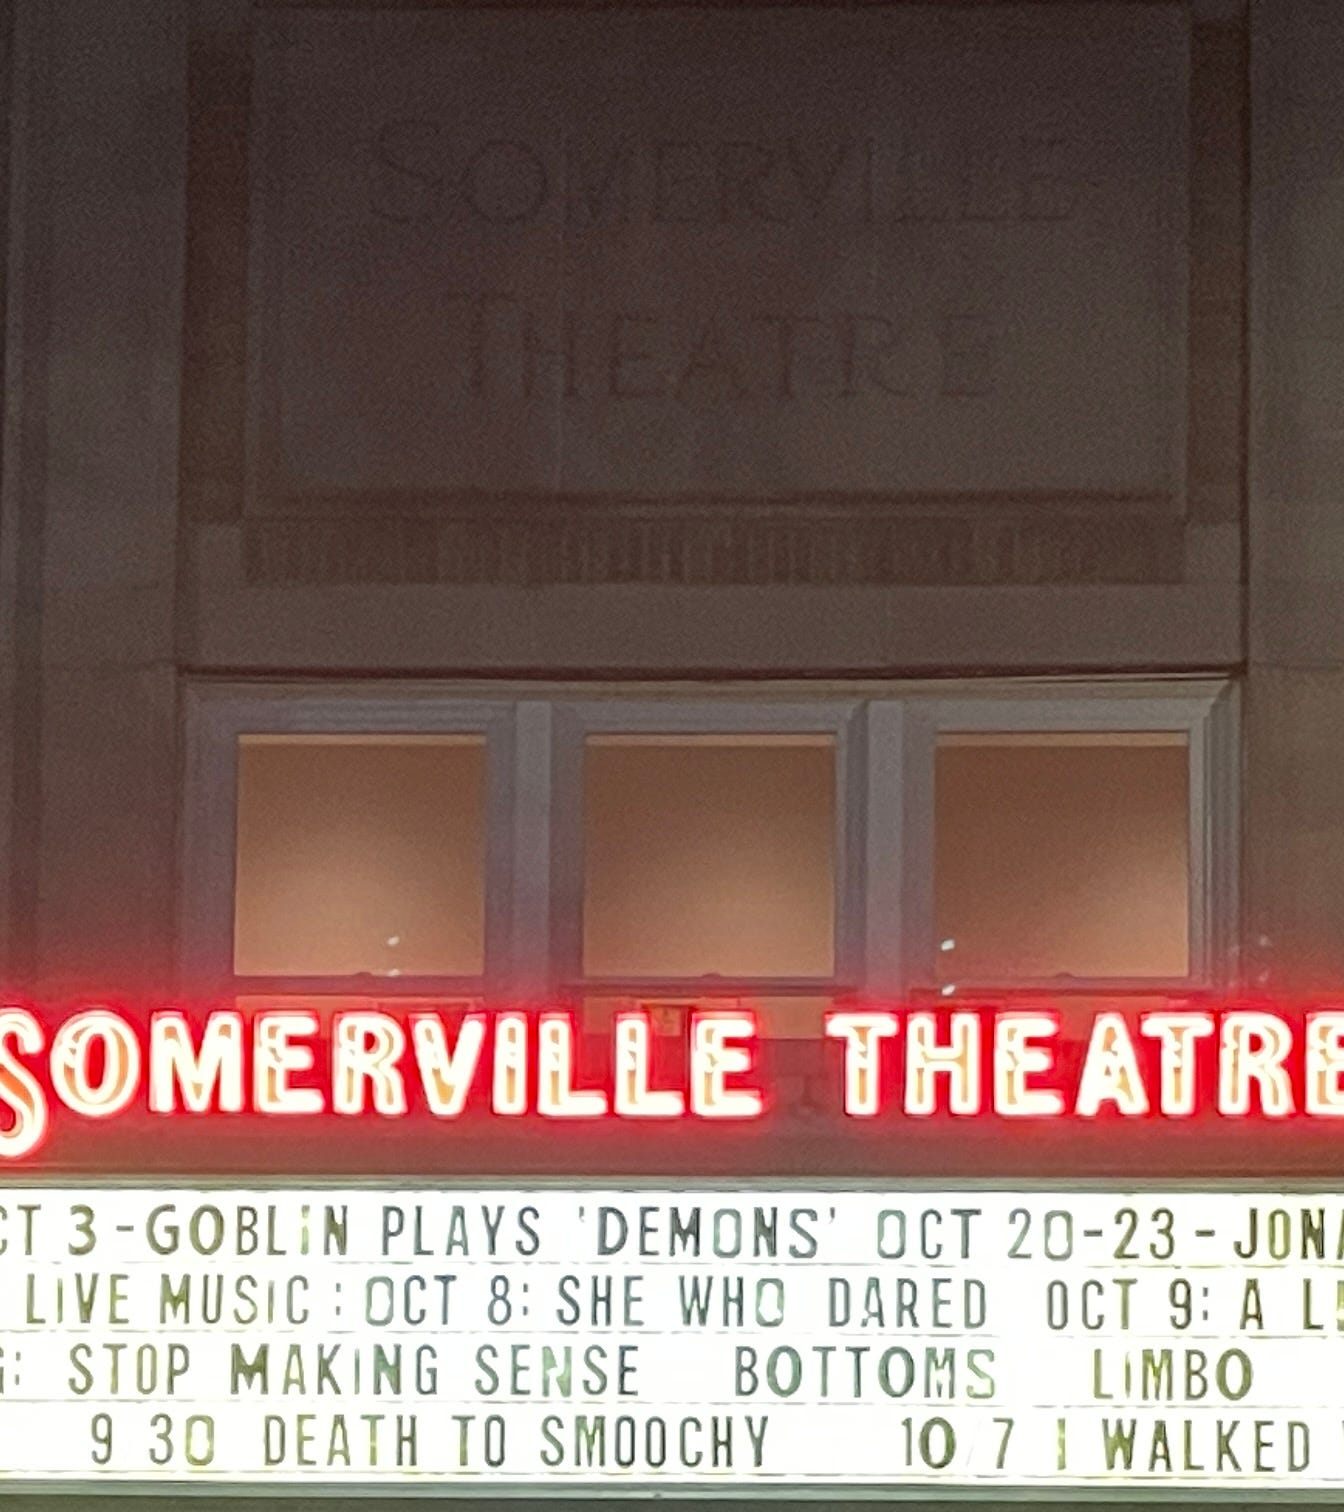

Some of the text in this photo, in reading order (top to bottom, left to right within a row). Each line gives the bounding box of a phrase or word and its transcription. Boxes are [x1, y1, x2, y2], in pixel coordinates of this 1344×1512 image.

[368, 116, 1076, 226] SOMERVILLE
[444, 286, 998, 400] THEATRE
[381, 1205, 541, 1256] PLAYS
[577, 1206, 837, 1259] 'DEMONS'
[876, 1208, 983, 1260] OCT
[25, 1272, 130, 1325] LIVE
[364, 1274, 458, 1327] OCT
[486, 1274, 530, 1326] 8:
[555, 1274, 645, 1327] SHE
[678, 1275, 786, 1328] WHO
[828, 1276, 987, 1329] DARED
[1046, 1278, 1138, 1331] OCT
[1167, 1277, 1210, 1331] 9:
[1238, 1277, 1265, 1331] A
[67, 1342, 191, 1396] STOP
[229, 1343, 439, 1396] MAKING
[474, 1344, 640, 1398] SENSE
[734, 1345, 996, 1400] BOTTOMS
[1092, 1347, 1254, 1402] LIMBO
[262, 1413, 418, 1467] DEATH
[452, 1414, 507, 1468] TO
[539, 1415, 770, 1470] SMOOCHY
[1056, 1418, 1068, 1471] I
[1100, 1418, 1311, 1473] WALKED
